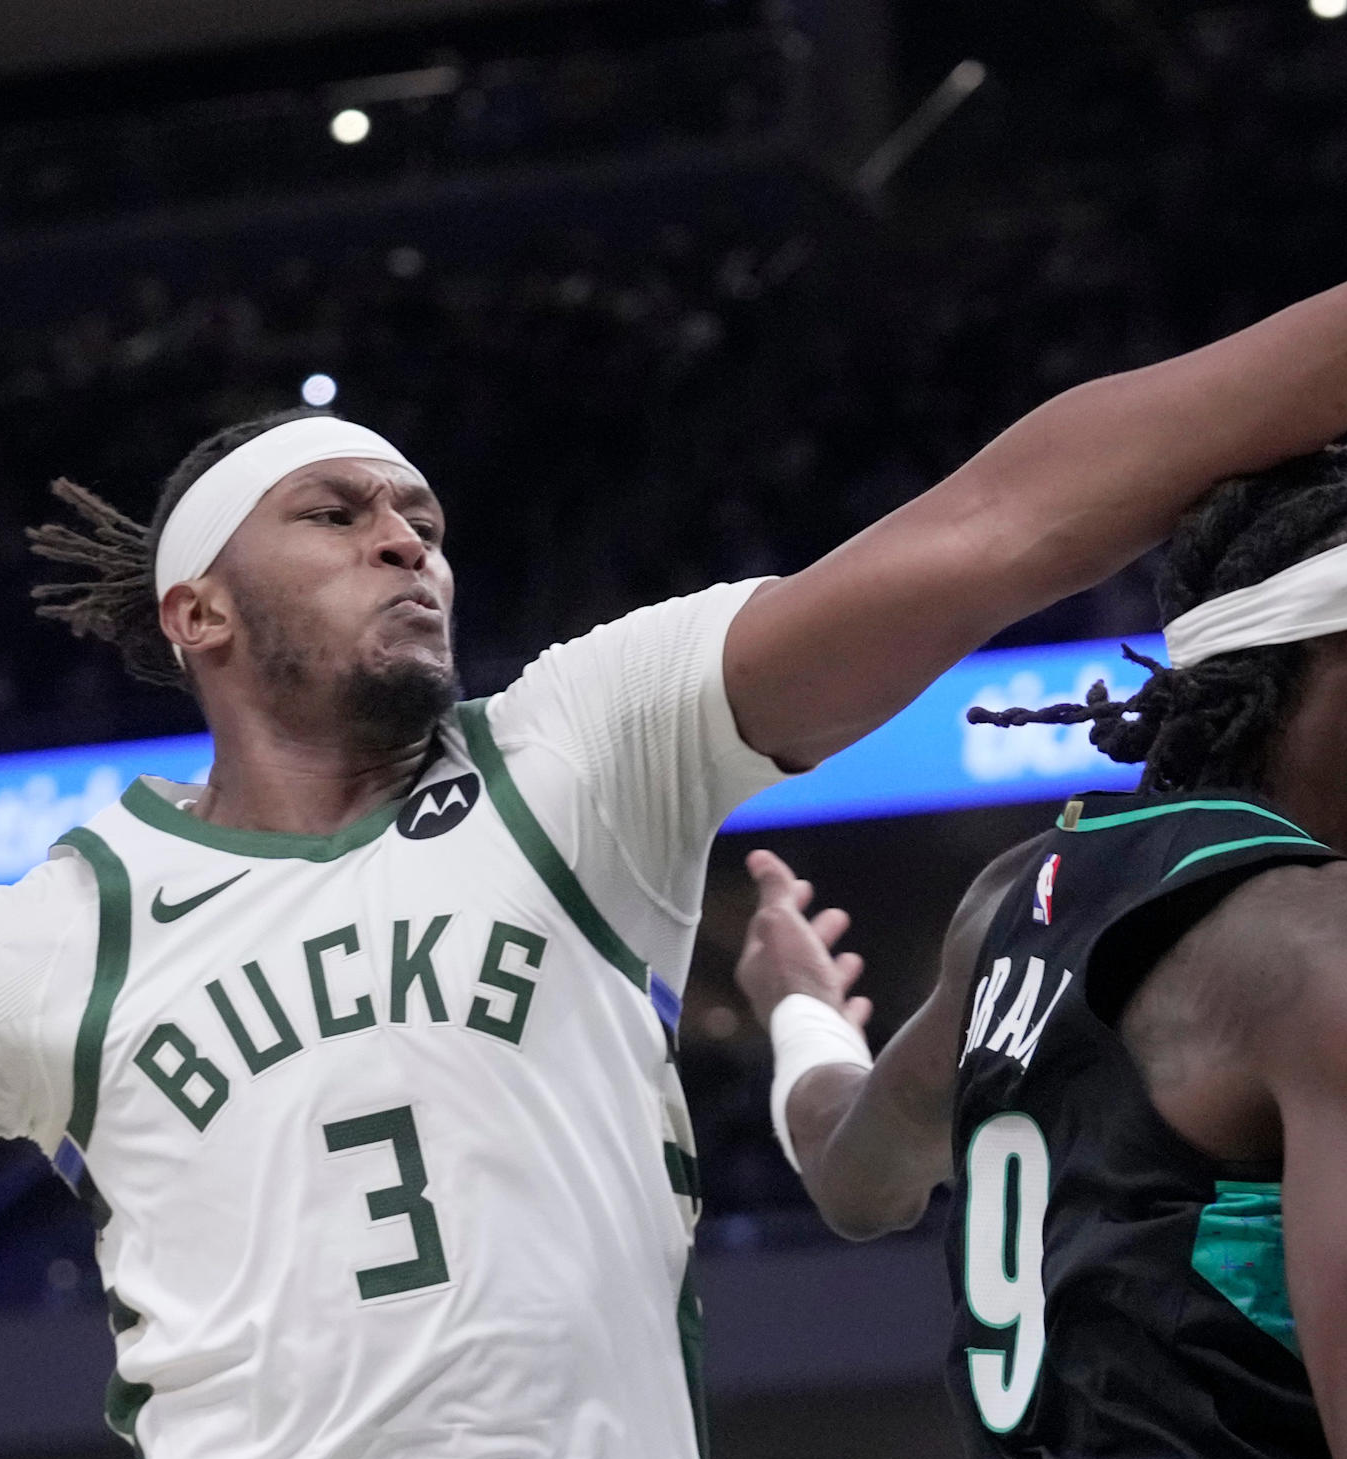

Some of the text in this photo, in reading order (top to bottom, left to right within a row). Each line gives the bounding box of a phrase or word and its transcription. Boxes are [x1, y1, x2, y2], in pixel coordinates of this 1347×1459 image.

[133, 913, 548, 1134] BUCKS
[322, 1104, 450, 1301] 3
[964, 1112, 1050, 1434] 9
